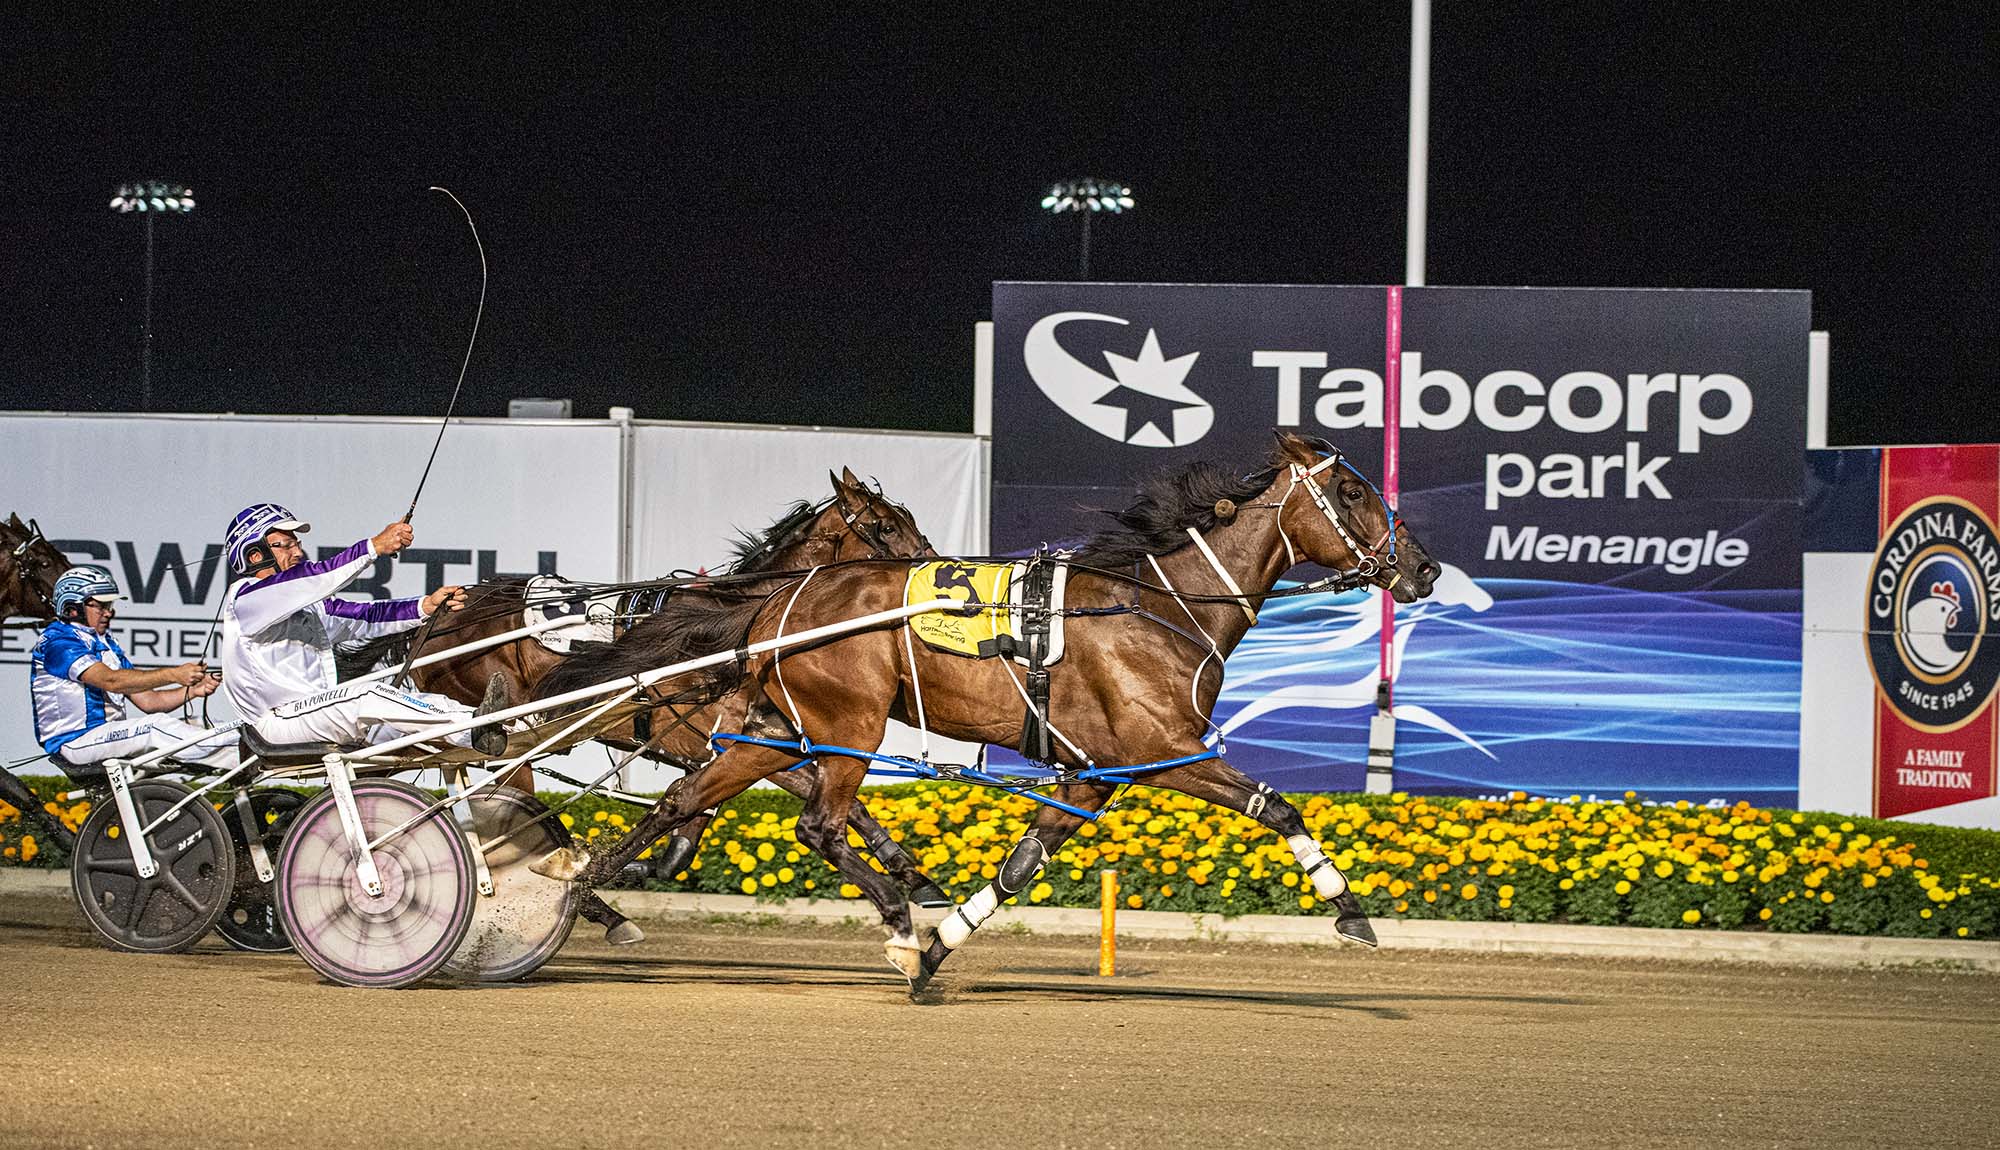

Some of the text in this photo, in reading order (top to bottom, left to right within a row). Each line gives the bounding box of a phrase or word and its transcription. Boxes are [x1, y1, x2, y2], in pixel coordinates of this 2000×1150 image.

[1252, 350, 1753, 453] Tabcorp
[1485, 442, 1672, 510] park
[1484, 526, 1749, 574] Menangle
[1874, 511, 1957, 618] CORDINA
[1899, 680, 1975, 710] SINCE 1945
[1896, 768, 1973, 789] TRADITION
[1904, 749, 1966, 768] A FAMILY
